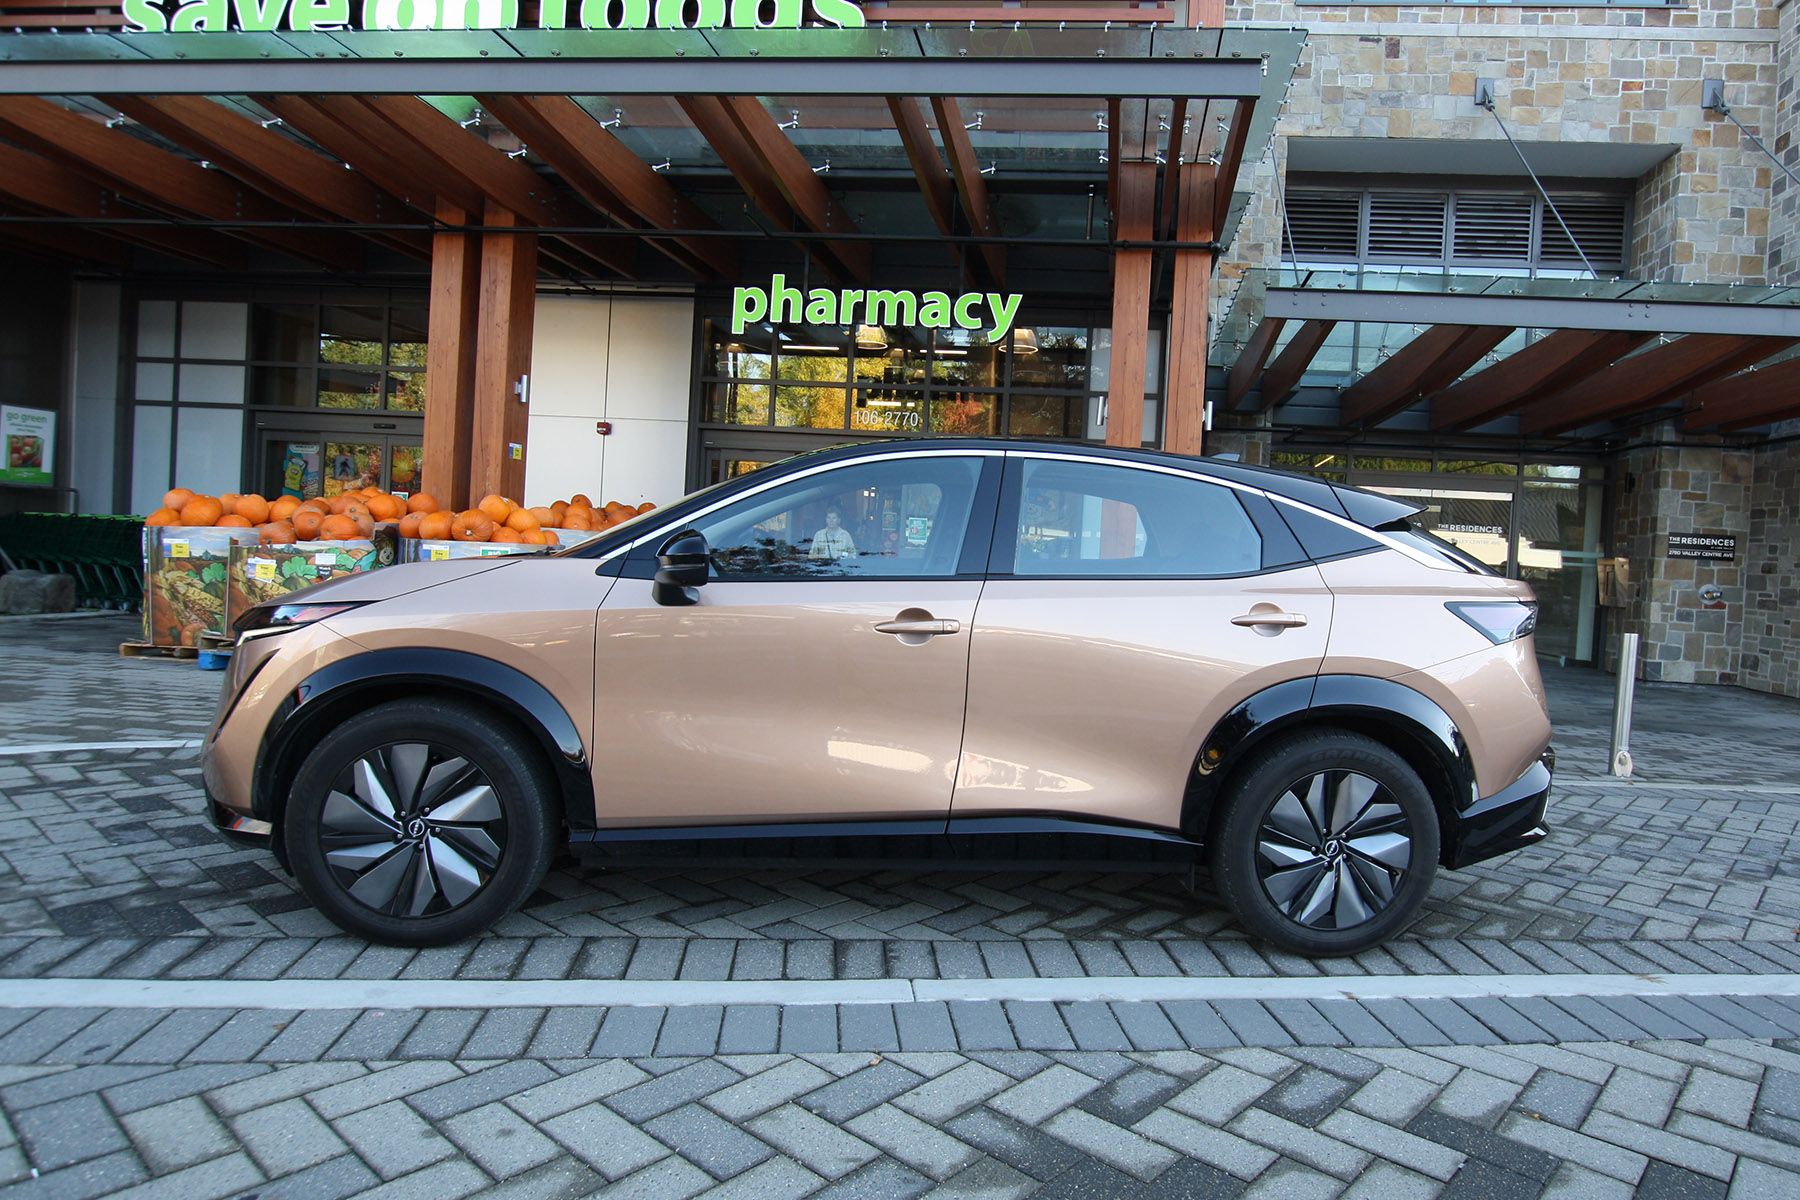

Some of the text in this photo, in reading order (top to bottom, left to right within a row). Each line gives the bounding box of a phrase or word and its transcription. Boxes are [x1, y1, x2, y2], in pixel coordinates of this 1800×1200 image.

[731, 273, 1023, 343] pharmacy
[6, 411, 48, 424] go green
[1449, 524, 1503, 534] RESIDENCES
[1681, 537, 1735, 547] RESIDENCES
